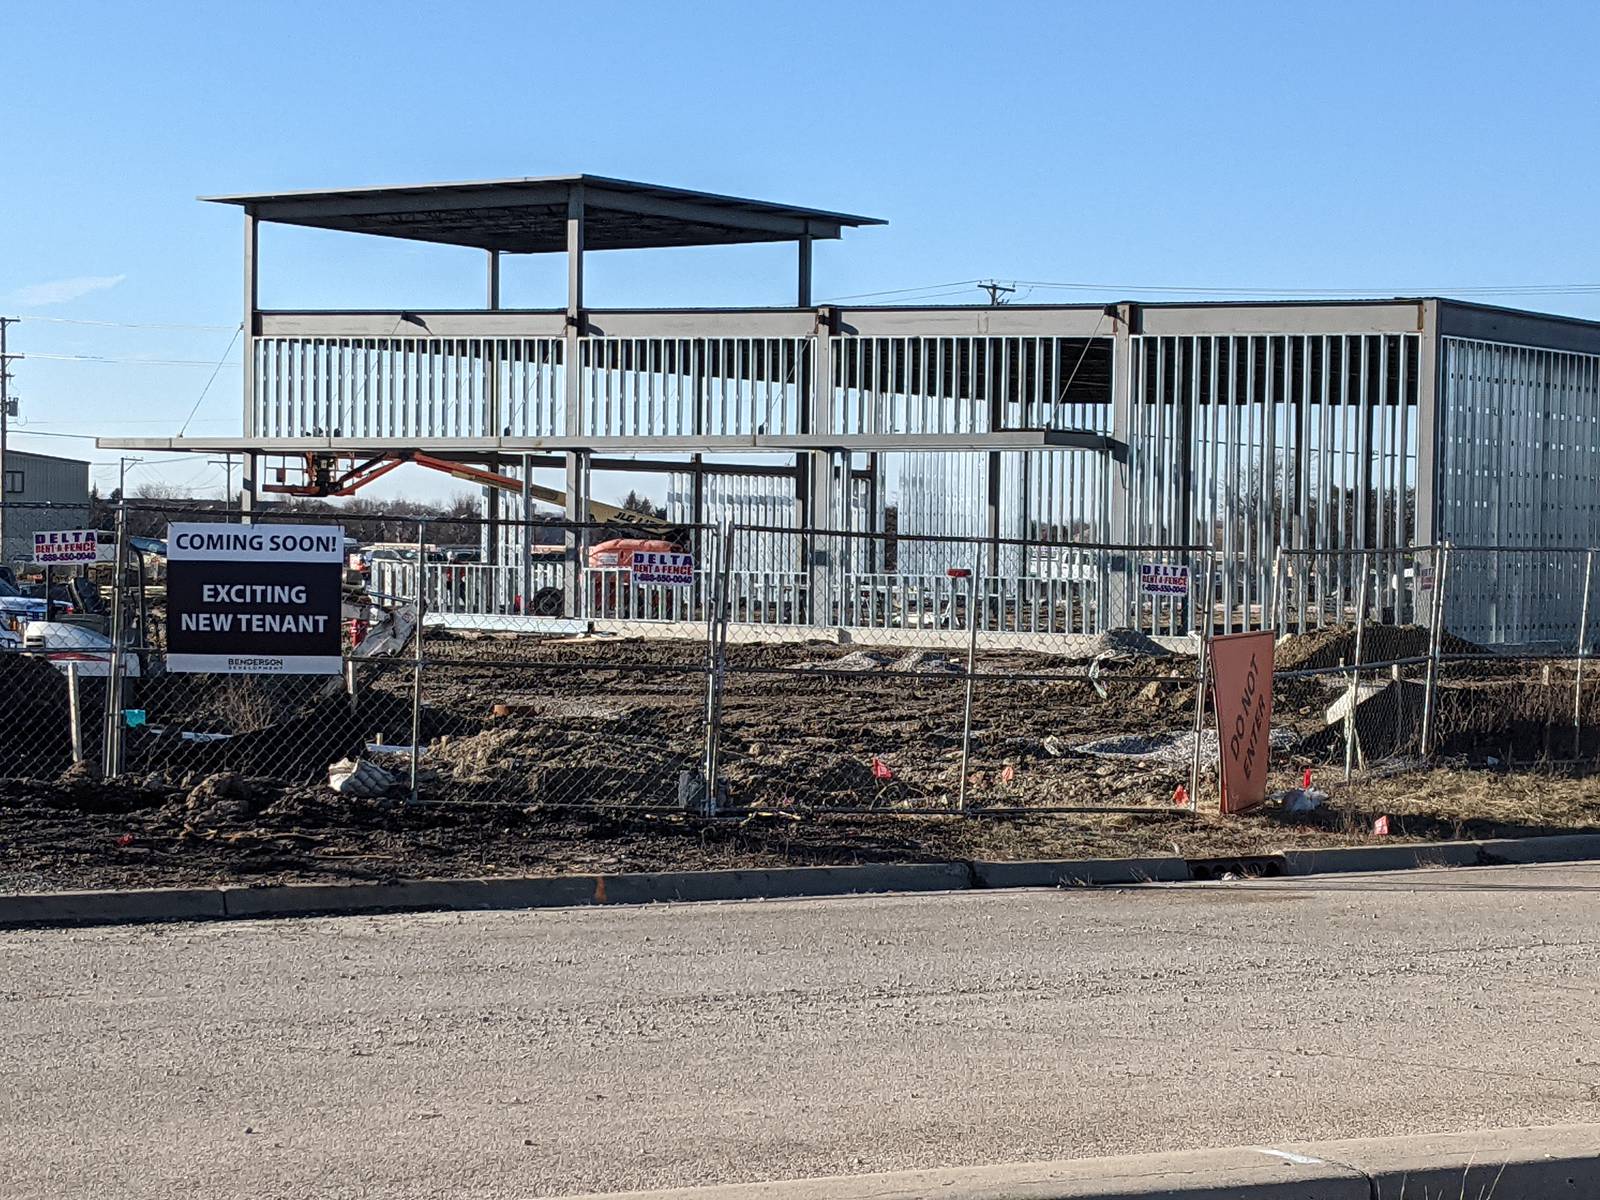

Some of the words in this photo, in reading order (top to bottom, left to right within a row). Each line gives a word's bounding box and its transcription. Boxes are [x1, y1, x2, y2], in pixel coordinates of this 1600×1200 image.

[35, 532, 96, 545] DELTA
[176, 534, 263, 551] COMING
[270, 536, 337, 552] SOON!
[64, 541, 96, 552] FENCE
[634, 553, 692, 565] DELTA
[662, 566, 692, 575] FENCE
[1143, 565, 1187, 576] DELTA
[202, 584, 307, 603] EXCITING
[181, 613, 233, 631] NEW
[237, 614, 328, 633] TENANT
[228, 658, 283, 666] BENDERSON
[1231, 714, 1244, 760] DO
[1242, 653, 1259, 716] NOT
[1243, 694, 1266, 779] ENTER
